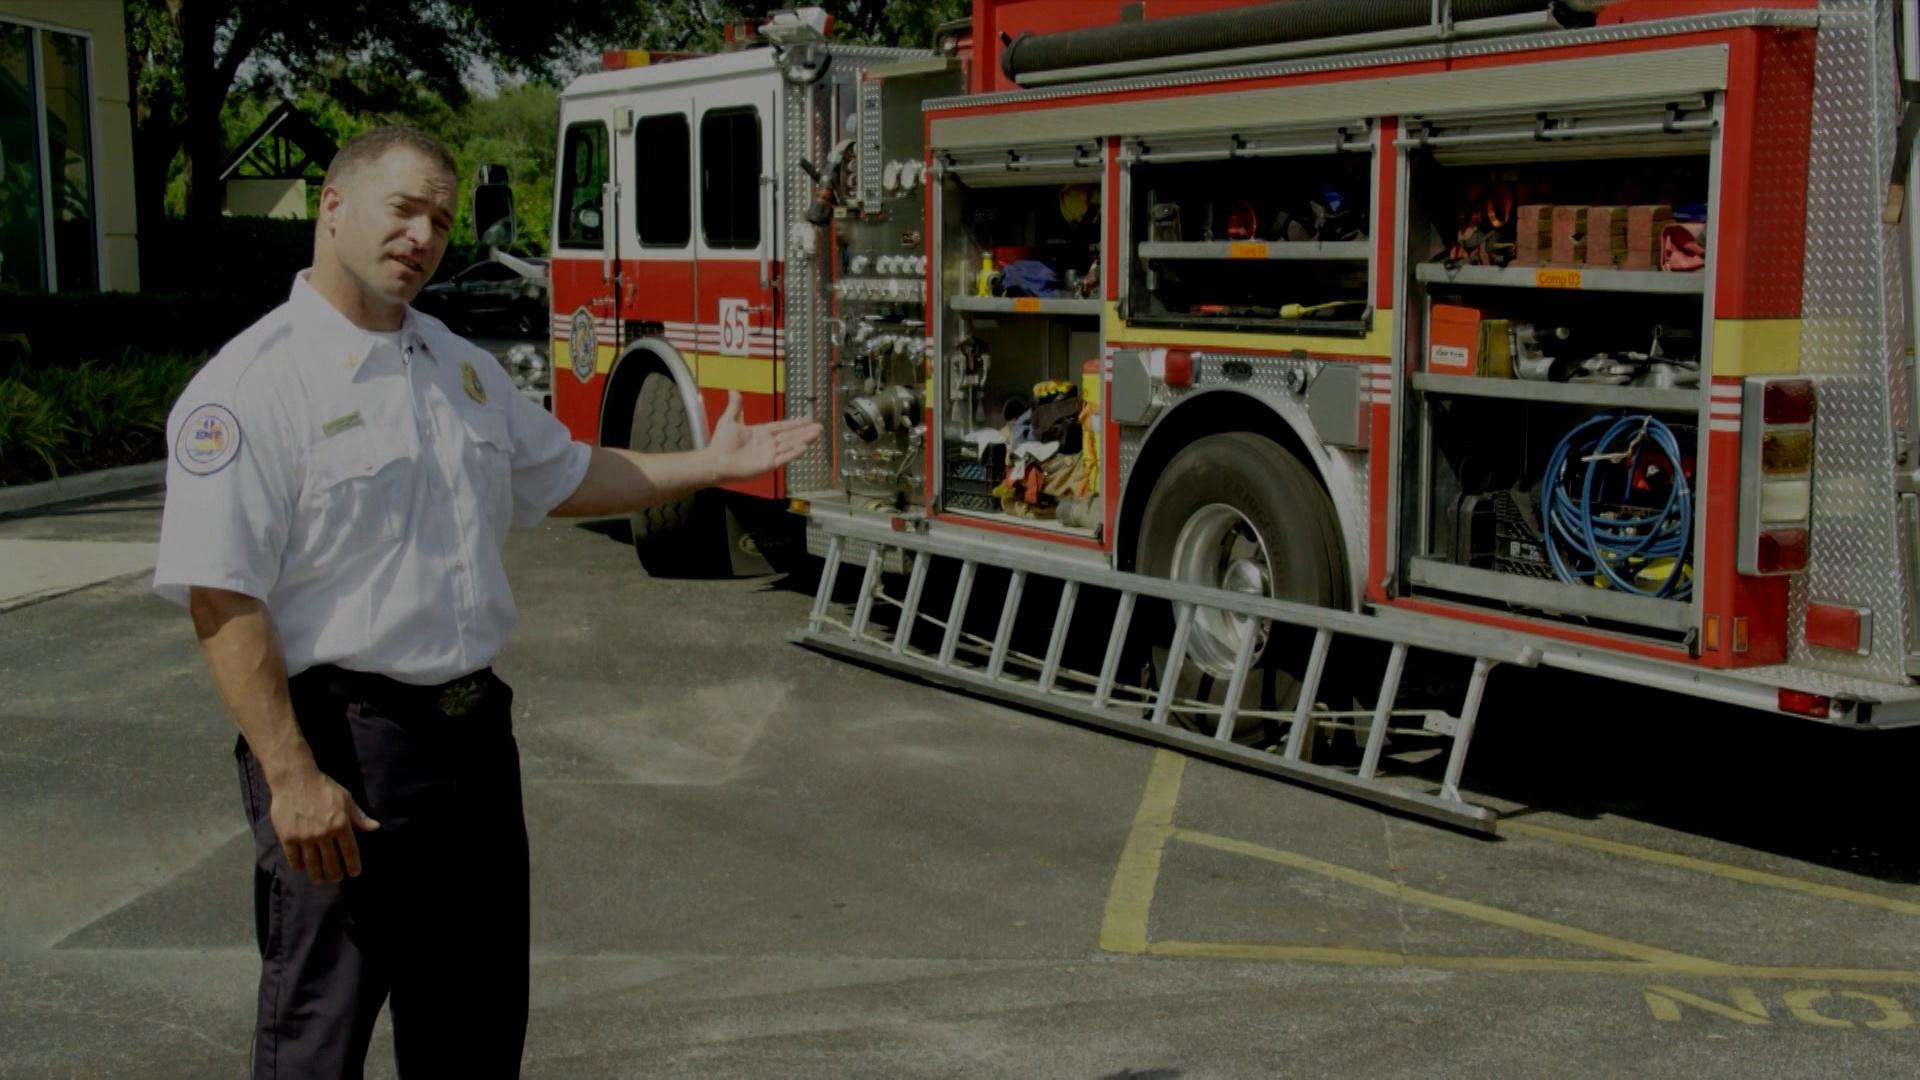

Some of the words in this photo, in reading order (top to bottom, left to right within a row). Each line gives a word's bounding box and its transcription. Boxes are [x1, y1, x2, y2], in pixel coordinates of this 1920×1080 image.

[1538, 271, 1567, 287] Comp
[723, 305, 746, 350] 65
[1643, 983, 1914, 1031] NO
